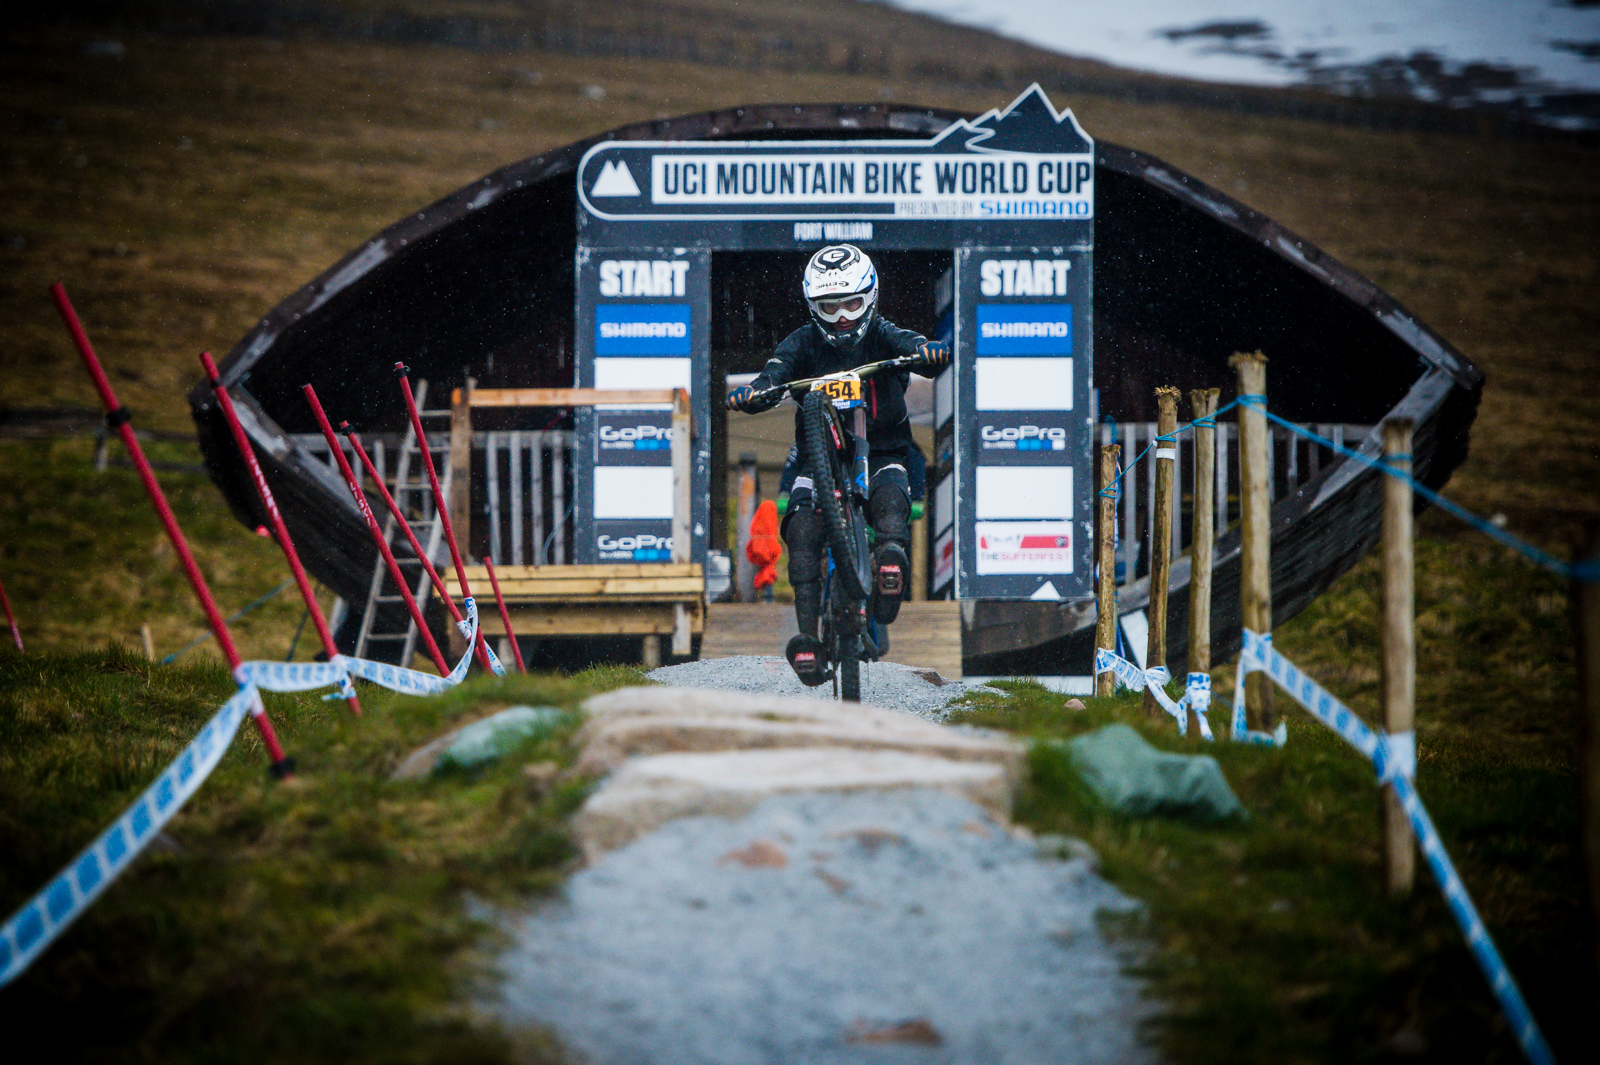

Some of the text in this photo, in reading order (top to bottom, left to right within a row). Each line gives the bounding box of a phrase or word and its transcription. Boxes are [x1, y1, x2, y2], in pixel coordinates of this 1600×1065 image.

[664, 162, 1091, 195] UCI MOUNTAIN BIKE WORLD CUP
[980, 201, 1090, 215] SHIMANO
[599, 260, 690, 297] START
[980, 259, 1071, 297] START
[600, 322, 687, 338] SHIMANO
[981, 322, 1068, 338] SHIMANO
[981, 425, 1066, 441] GoPro
